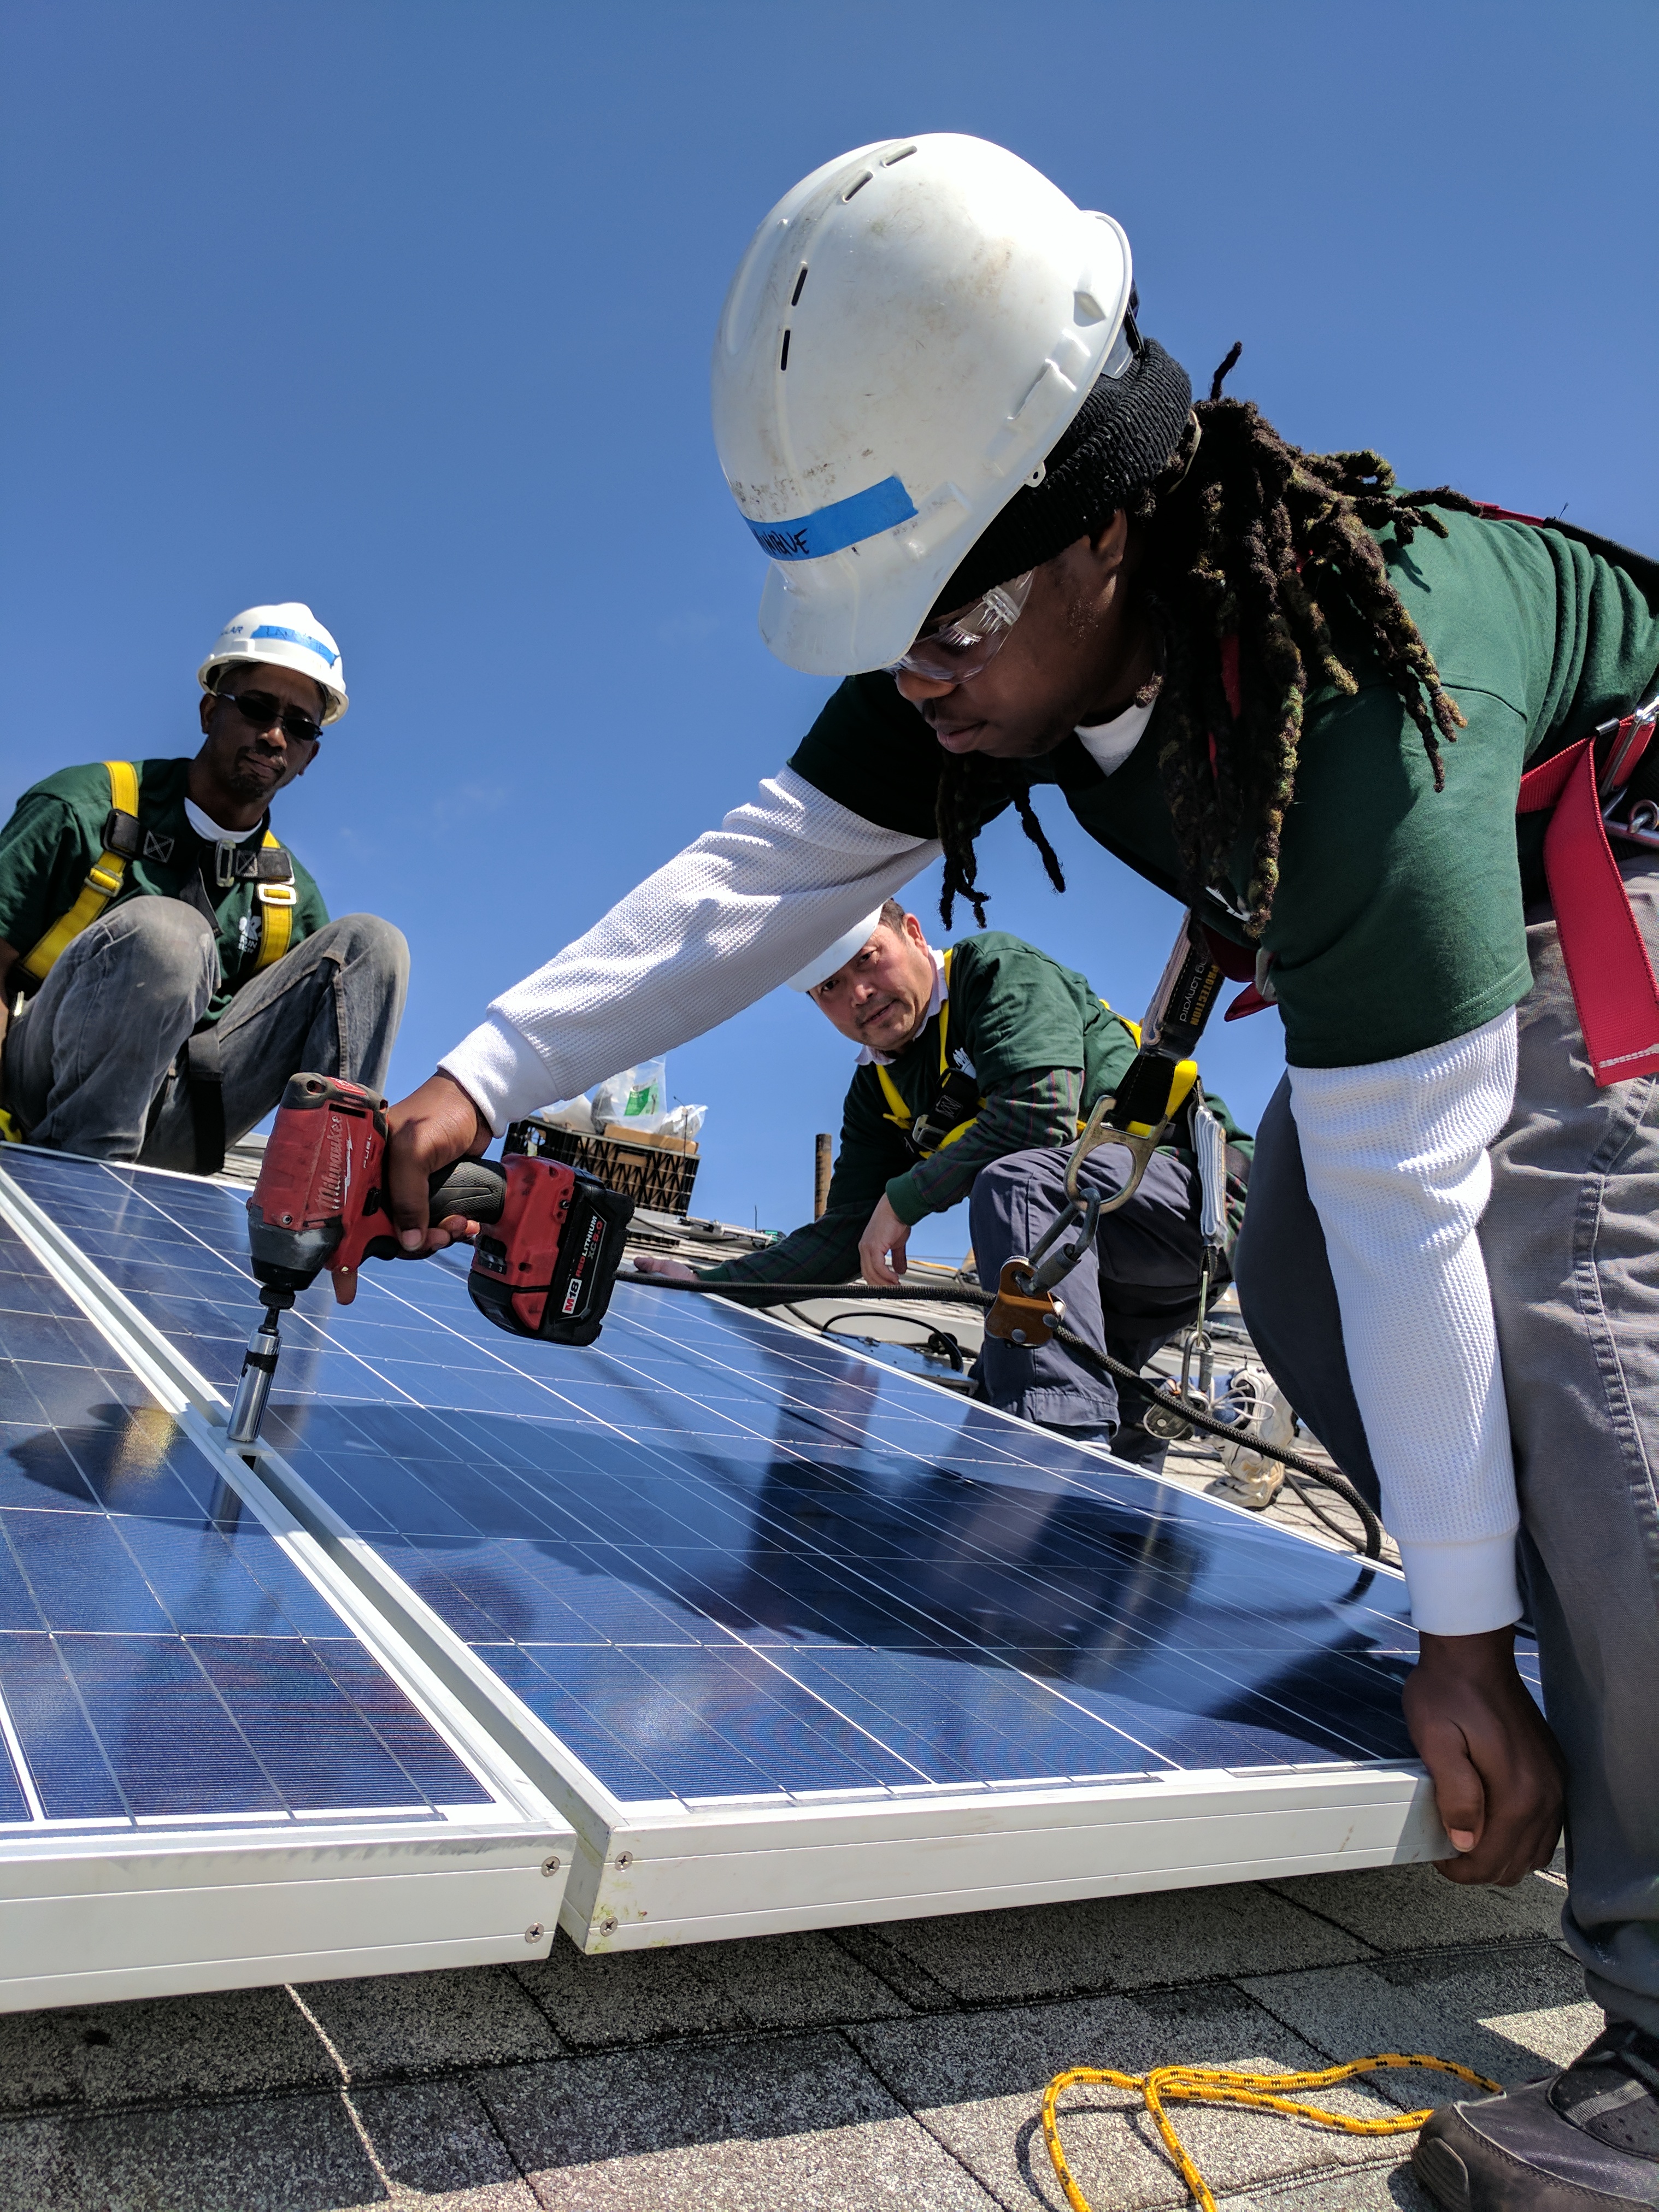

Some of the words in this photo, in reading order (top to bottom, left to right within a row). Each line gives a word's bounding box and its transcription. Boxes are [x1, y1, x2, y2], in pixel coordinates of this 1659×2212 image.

[1179, 976, 1202, 1022] Lanyard
[1190, 964, 1220, 1026] PROTECTION
[363, 1133, 373, 1169] FUEL
[564, 1280, 579, 1311] M18
[575, 1215, 598, 1278] REDLITHIUM
